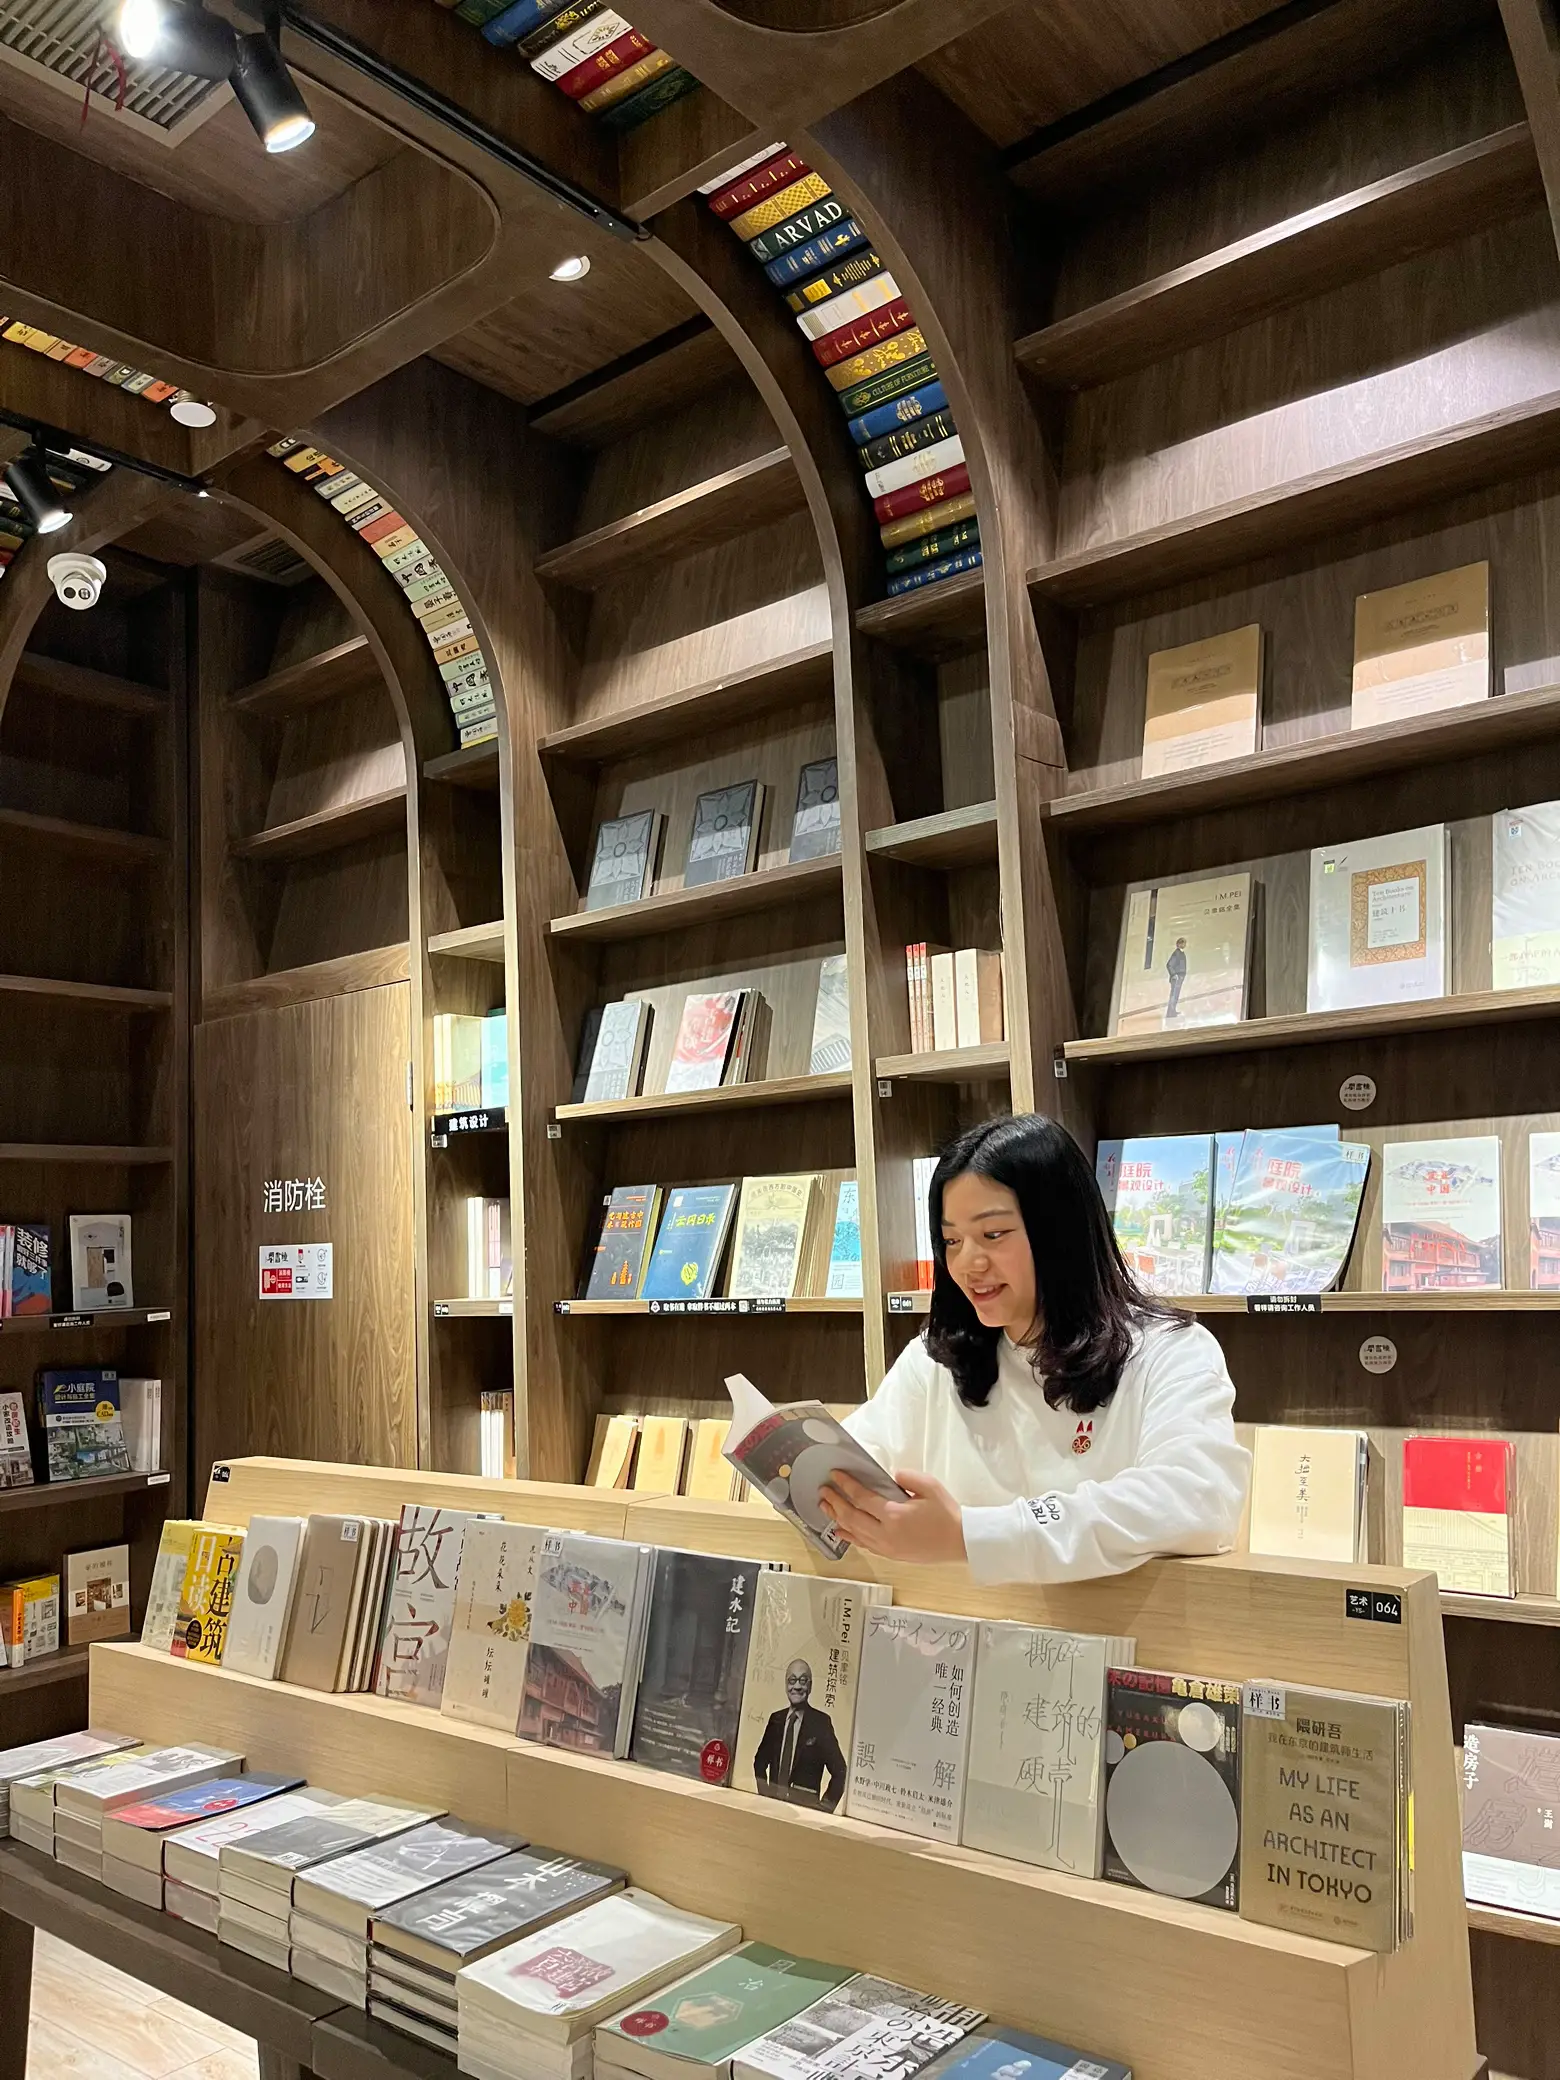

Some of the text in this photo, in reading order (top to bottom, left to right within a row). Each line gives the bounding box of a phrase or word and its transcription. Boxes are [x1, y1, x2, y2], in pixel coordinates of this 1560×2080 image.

[448, 1114, 489, 1132] 建筑设计
[1268, 1159, 1303, 1180] 庭院
[264, 1176, 326, 1212] 消防栓
[1262, 1177, 1314, 1196] 景观设计
[16, 1227, 48, 1258] 装修
[16, 1253, 47, 1280] 就够了
[67, 1383, 96, 1393] 小庭院
[725, 1573, 746, 1634] 建水記
[1349, 1595, 1368, 1607] 艺术
[1376, 1601, 1398, 1616] 064
[841, 1598, 852, 1644] I.M.Pei
[870, 1615, 967, 1651] デザインの
[824, 1648, 839, 1708] 建筑探索
[1025, 1633, 1084, 1699] 撕碎
[930, 1662, 948, 1733] 唯一经典
[946, 1665, 964, 1737] 如何创造
[1249, 1692, 1280, 1711] 样书
[1023, 1693, 1102, 1765] 建筑的
[1296, 1717, 1341, 1740] 隈研吾
[706, 1754, 724, 1768] 样书
[1268, 1732, 1374, 1761] 我在东京的建筑师生活
[1463, 1733, 1481, 1790] 造房子
[932, 1759, 956, 1791] 解
[1280, 1767, 1360, 1800] MY LIFE
[1013, 1755, 1076, 1870] 硬壳
[1289, 1802, 1350, 1832] AS AN
[1264, 1829, 1377, 1871] ARCHITECT
[1267, 1863, 1372, 1904] IN TOKYO
